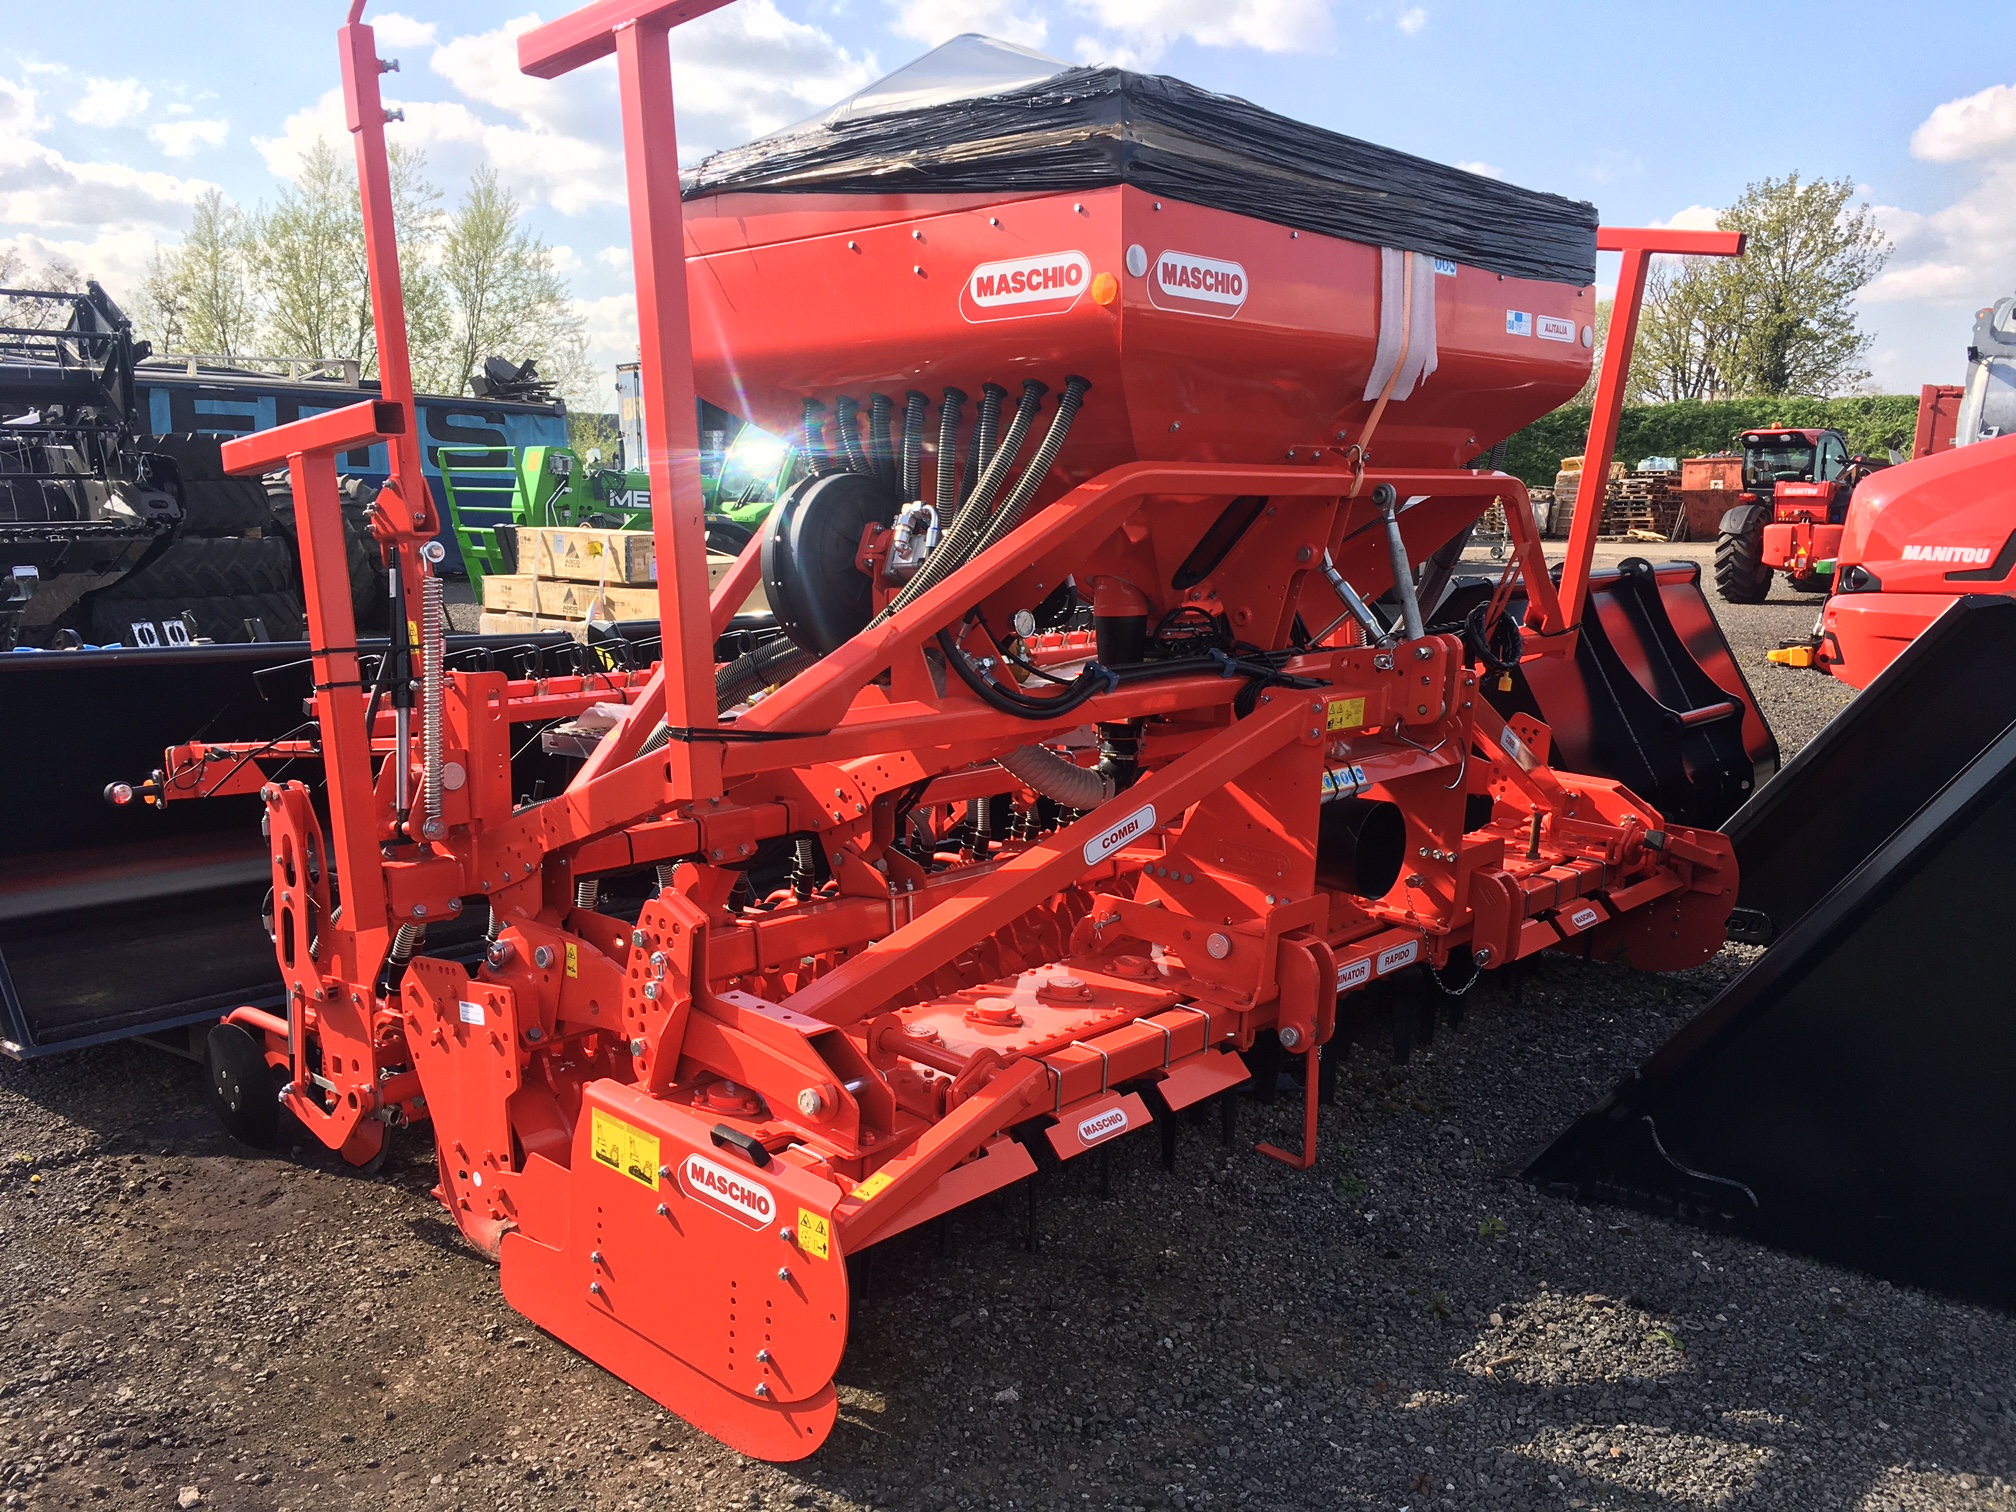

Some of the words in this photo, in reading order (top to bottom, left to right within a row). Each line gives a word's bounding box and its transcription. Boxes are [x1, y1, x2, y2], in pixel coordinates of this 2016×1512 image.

[976, 263, 1083, 298] MASCHIO
[1162, 262, 1242, 296] MASCHIO
[1545, 323, 1568, 335] ALITALIA
[1784, 487, 1819, 495] MANITOU
[1902, 545, 1990, 564] MANITOU
[1101, 819, 1139, 849] COMBI
[1384, 948, 1410, 967] RAPIDO
[1082, 1112, 1123, 1136] MASCHIO
[691, 1162, 770, 1215] MASCHIO
